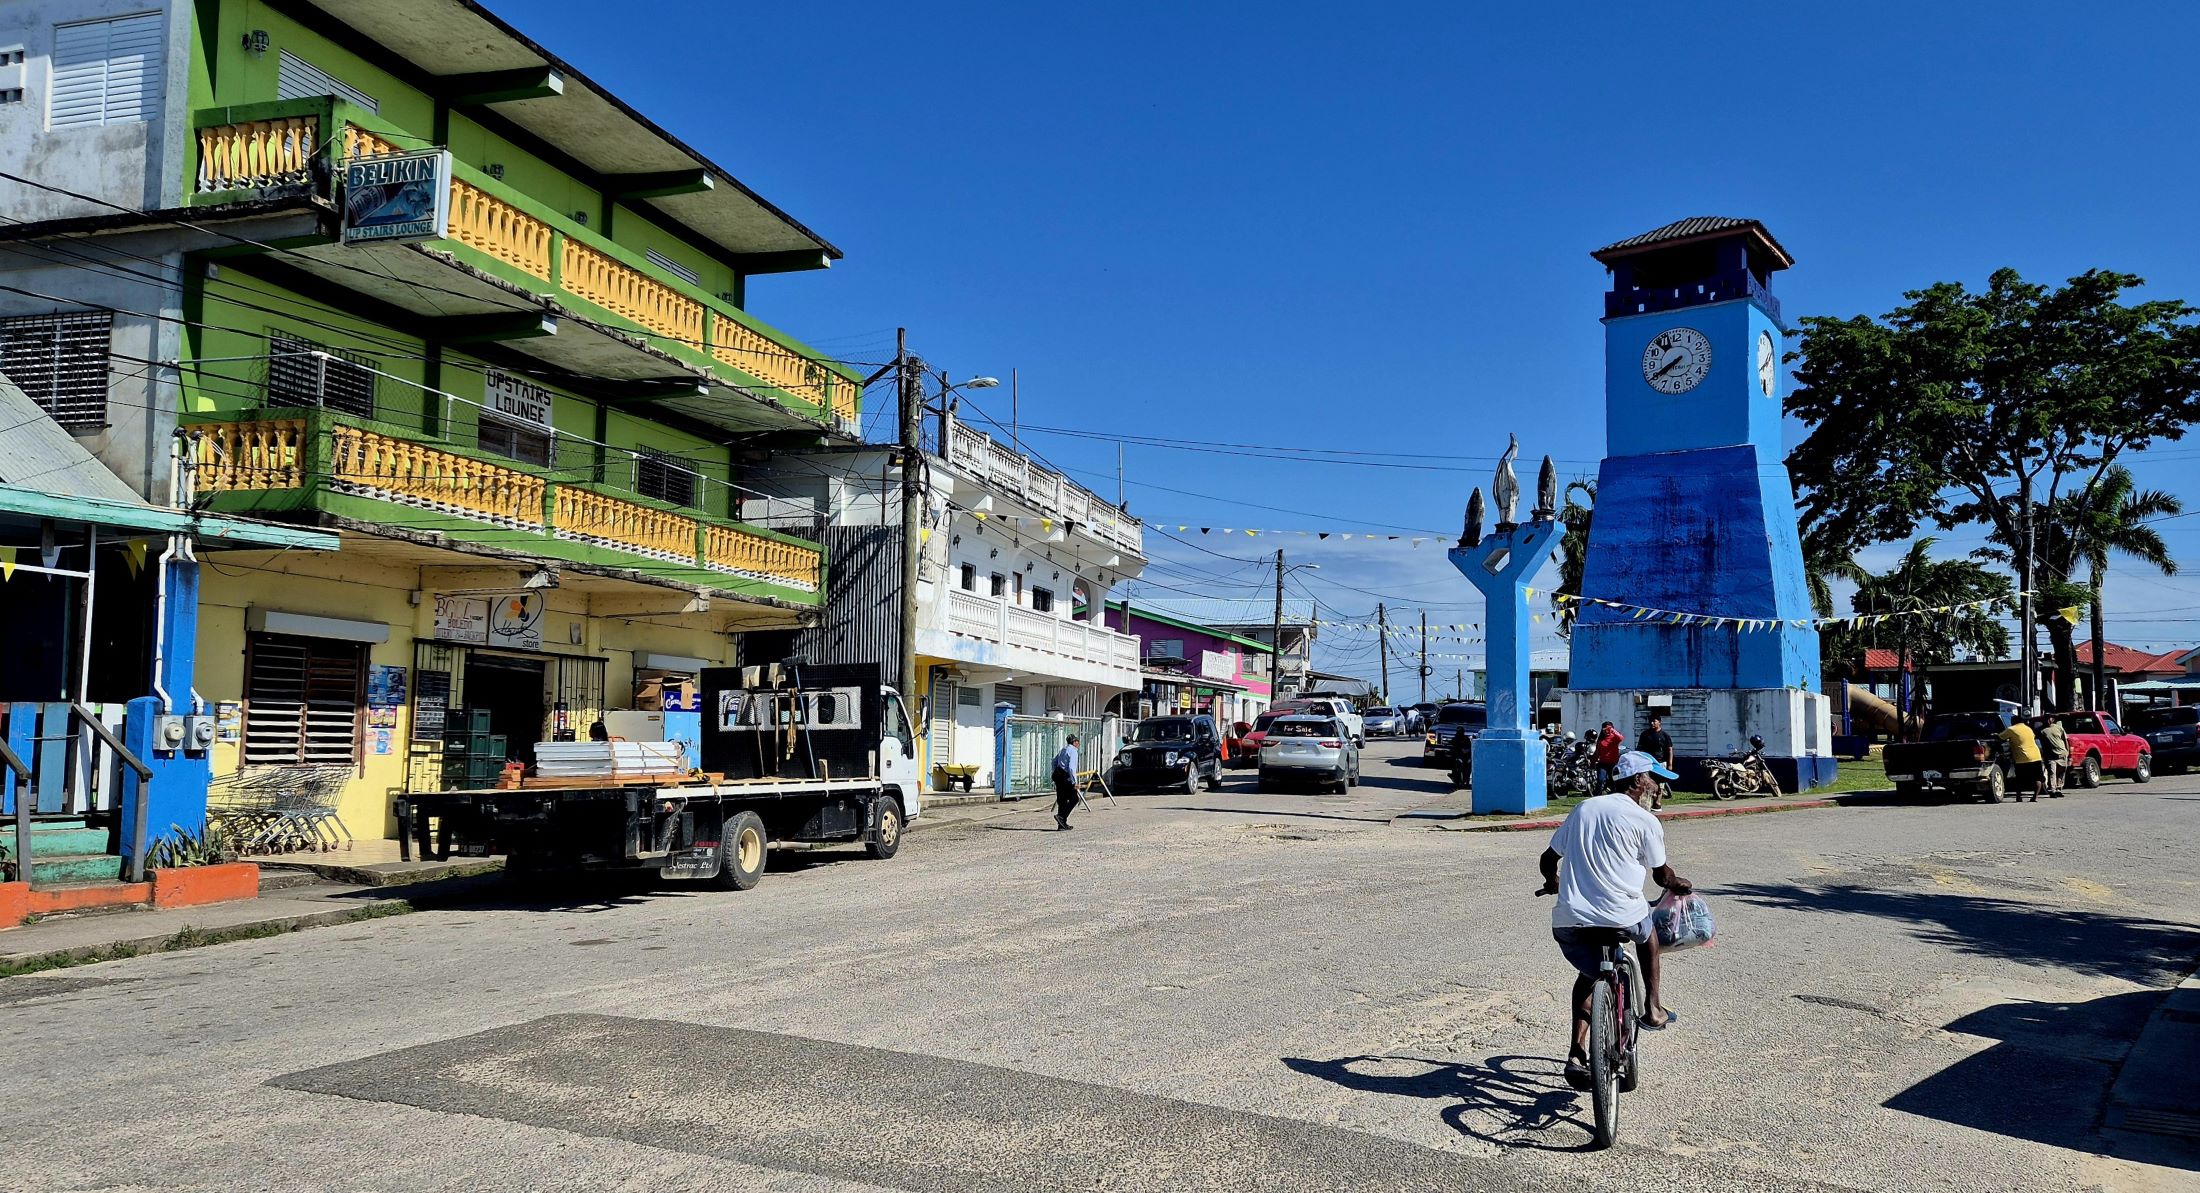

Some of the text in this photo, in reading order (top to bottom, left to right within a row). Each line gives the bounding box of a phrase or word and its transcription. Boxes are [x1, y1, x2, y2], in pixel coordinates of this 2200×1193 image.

[350, 156, 437, 188] BELIKIN
[349, 221, 433, 239] UP STAIRS LOUNGE
[1672, 333, 1682, 342] 12
[1687, 335, 1691, 343] 1
[1695, 341, 1703, 351] 2
[1650, 348, 1660, 357] 10
[1698, 354, 1706, 363] 3
[1648, 360, 1656, 370] 9
[1695, 366, 1702, 375] 4
[1661, 380, 1668, 389] 7
[1673, 380, 1681, 390] 6
[1685, 377, 1693, 386] 5
[486, 369, 552, 407] UPSTAIRS
[495, 393, 545, 425] LOUNGE
[522, 639, 539, 648] store
[1295, 725, 1312, 733] Sale
